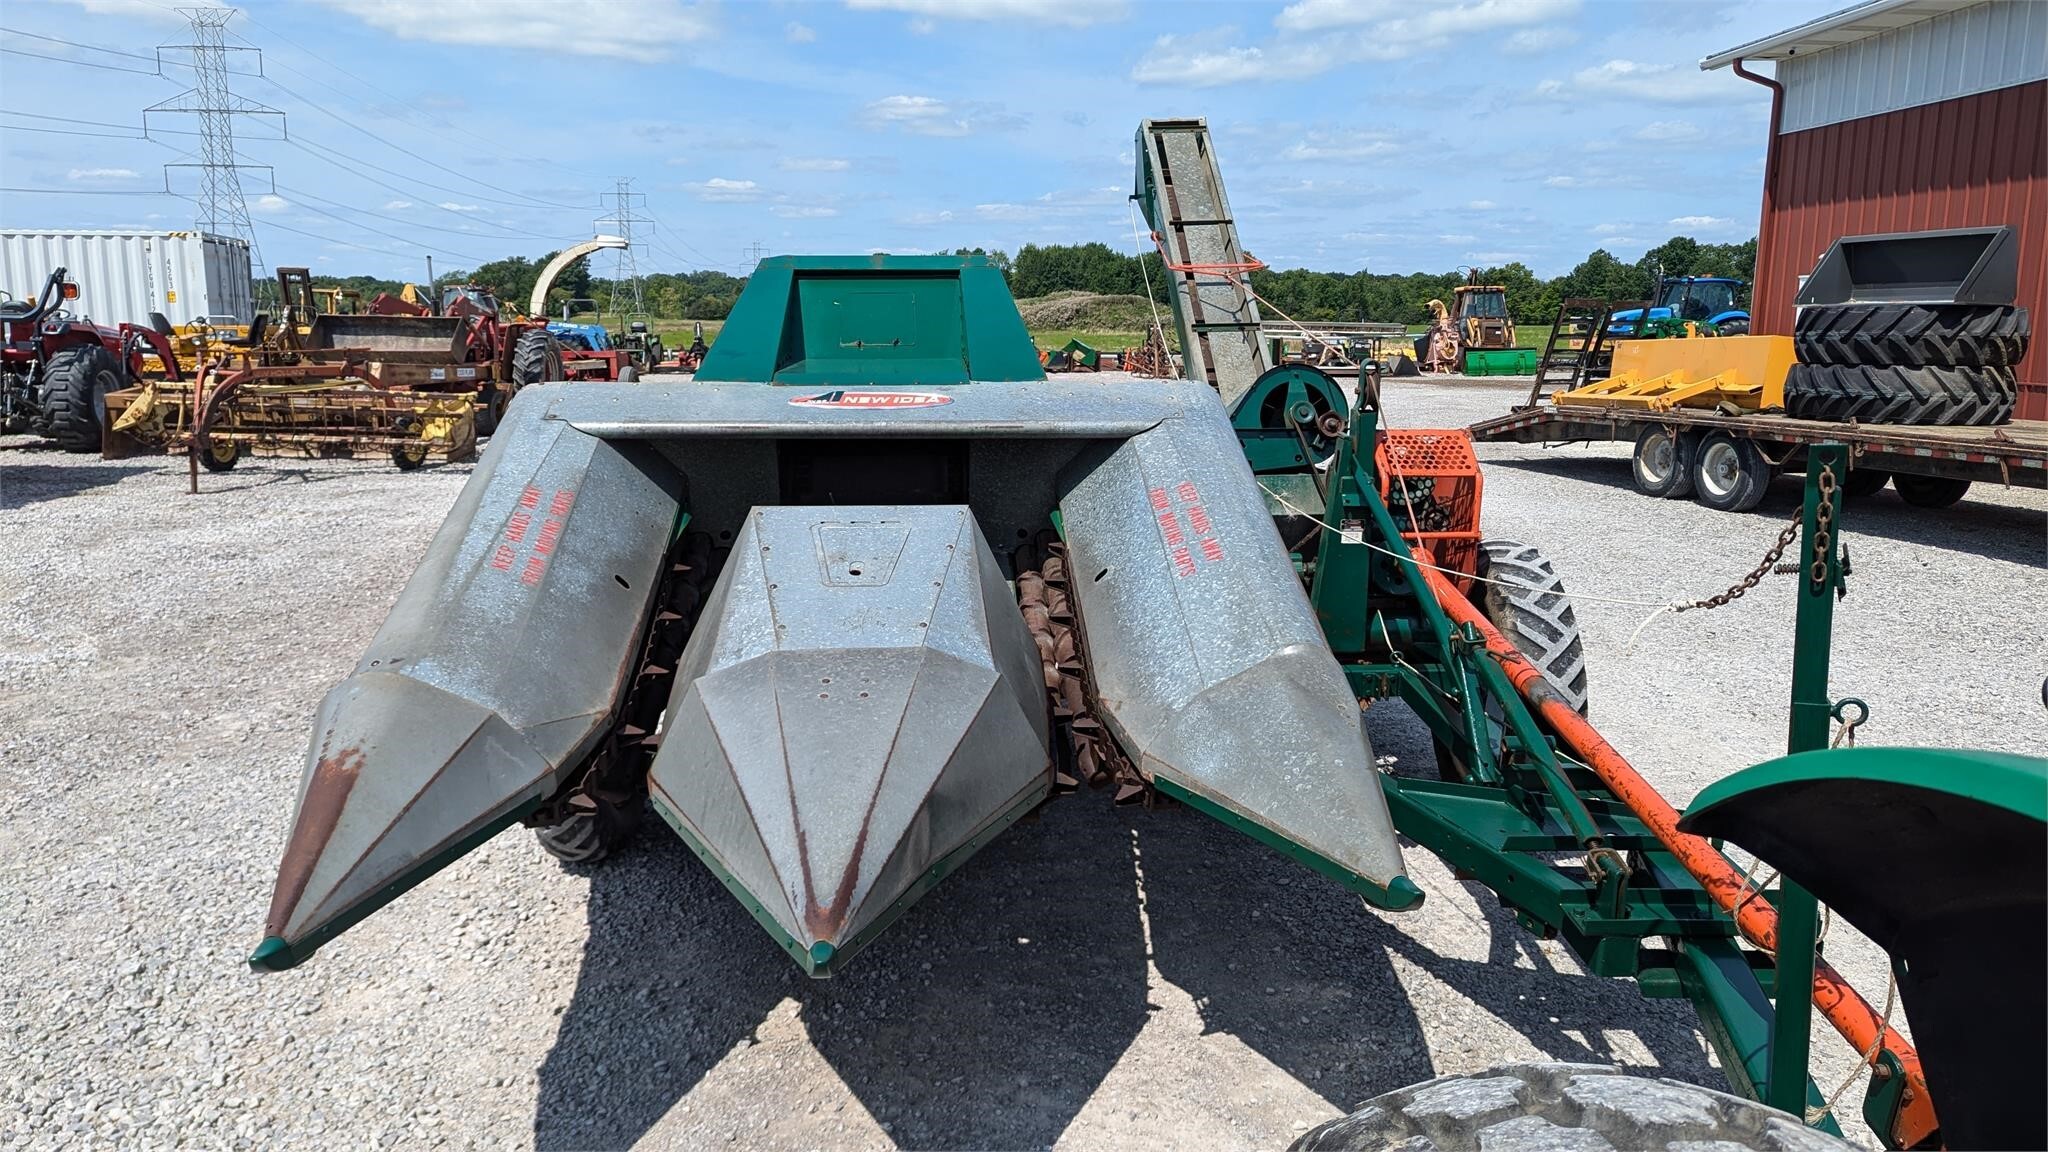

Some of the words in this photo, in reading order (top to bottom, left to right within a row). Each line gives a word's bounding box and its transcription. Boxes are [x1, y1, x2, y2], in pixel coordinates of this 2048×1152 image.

[843, 396, 889, 404] NEW
[893, 395, 939, 404] IDEA
[1149, 487, 1169, 511] FROM
[490, 545, 517, 571] KEEP
[504, 511, 532, 543] HANDS
[519, 485, 543, 510] AWAY
[520, 556, 545, 588] FROM
[533, 518, 562, 555] MOVING
[550, 489, 575, 517] PARTS
[1158, 512, 1184, 547] MOVING
[1174, 481, 1198, 502] KEEP
[1187, 506, 1212, 535] HANDS
[1200, 537, 1224, 562] AWAY
[1172, 547, 1197, 577] PARTS
